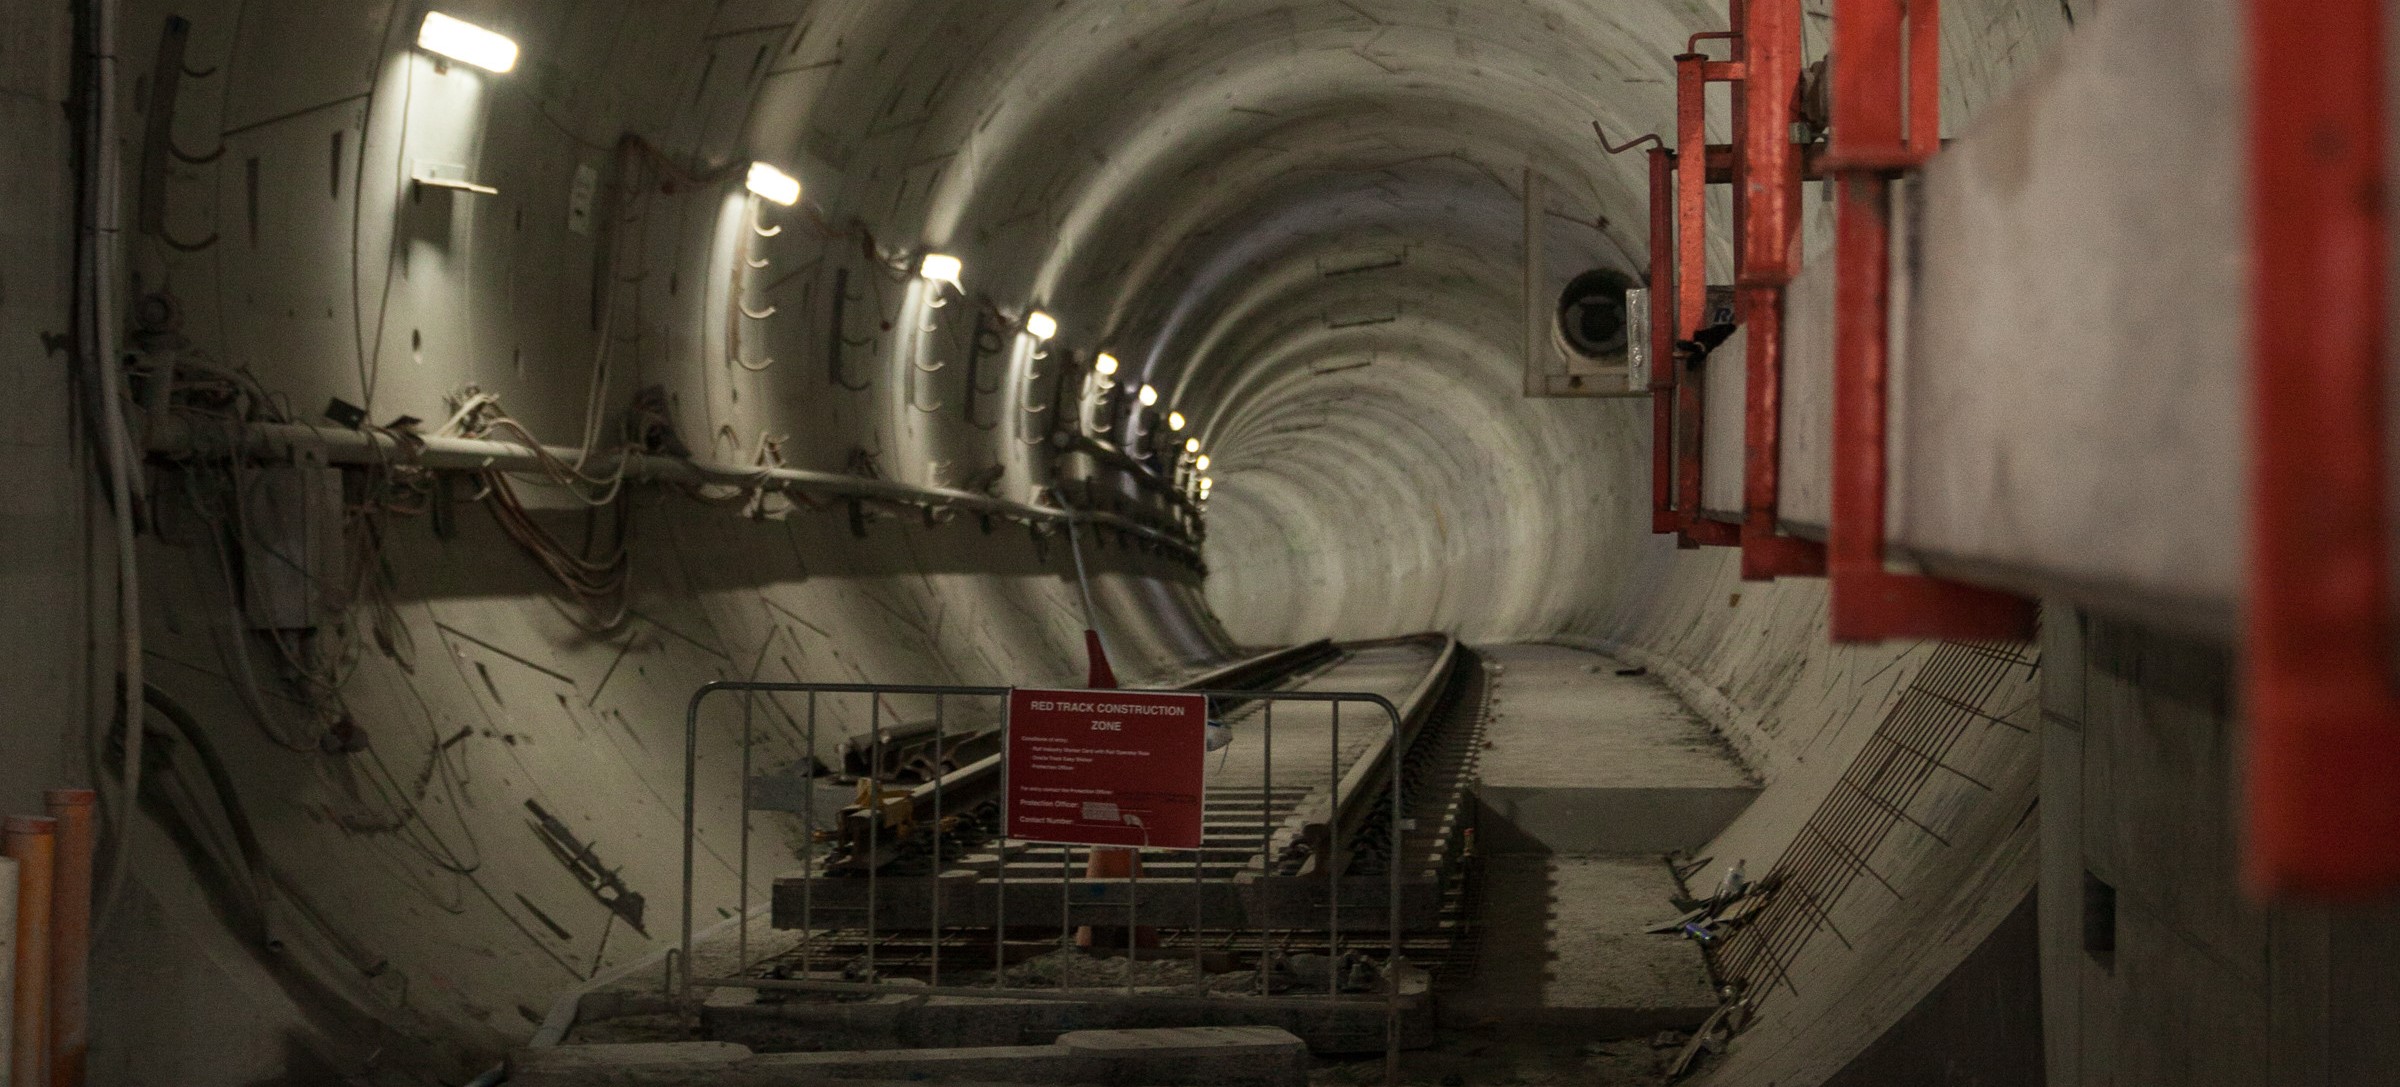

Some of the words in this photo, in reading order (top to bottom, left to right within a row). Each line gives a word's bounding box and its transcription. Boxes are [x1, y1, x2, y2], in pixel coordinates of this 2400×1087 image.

[1030, 700, 1054, 711] RED
[1056, 702, 1094, 713] TRACK
[1096, 703, 1184, 716] CONSTRUCTION
[1090, 720, 1122, 731] ZONE
[1019, 798, 1054, 807] Protection
[1019, 816, 1045, 824] Contact
